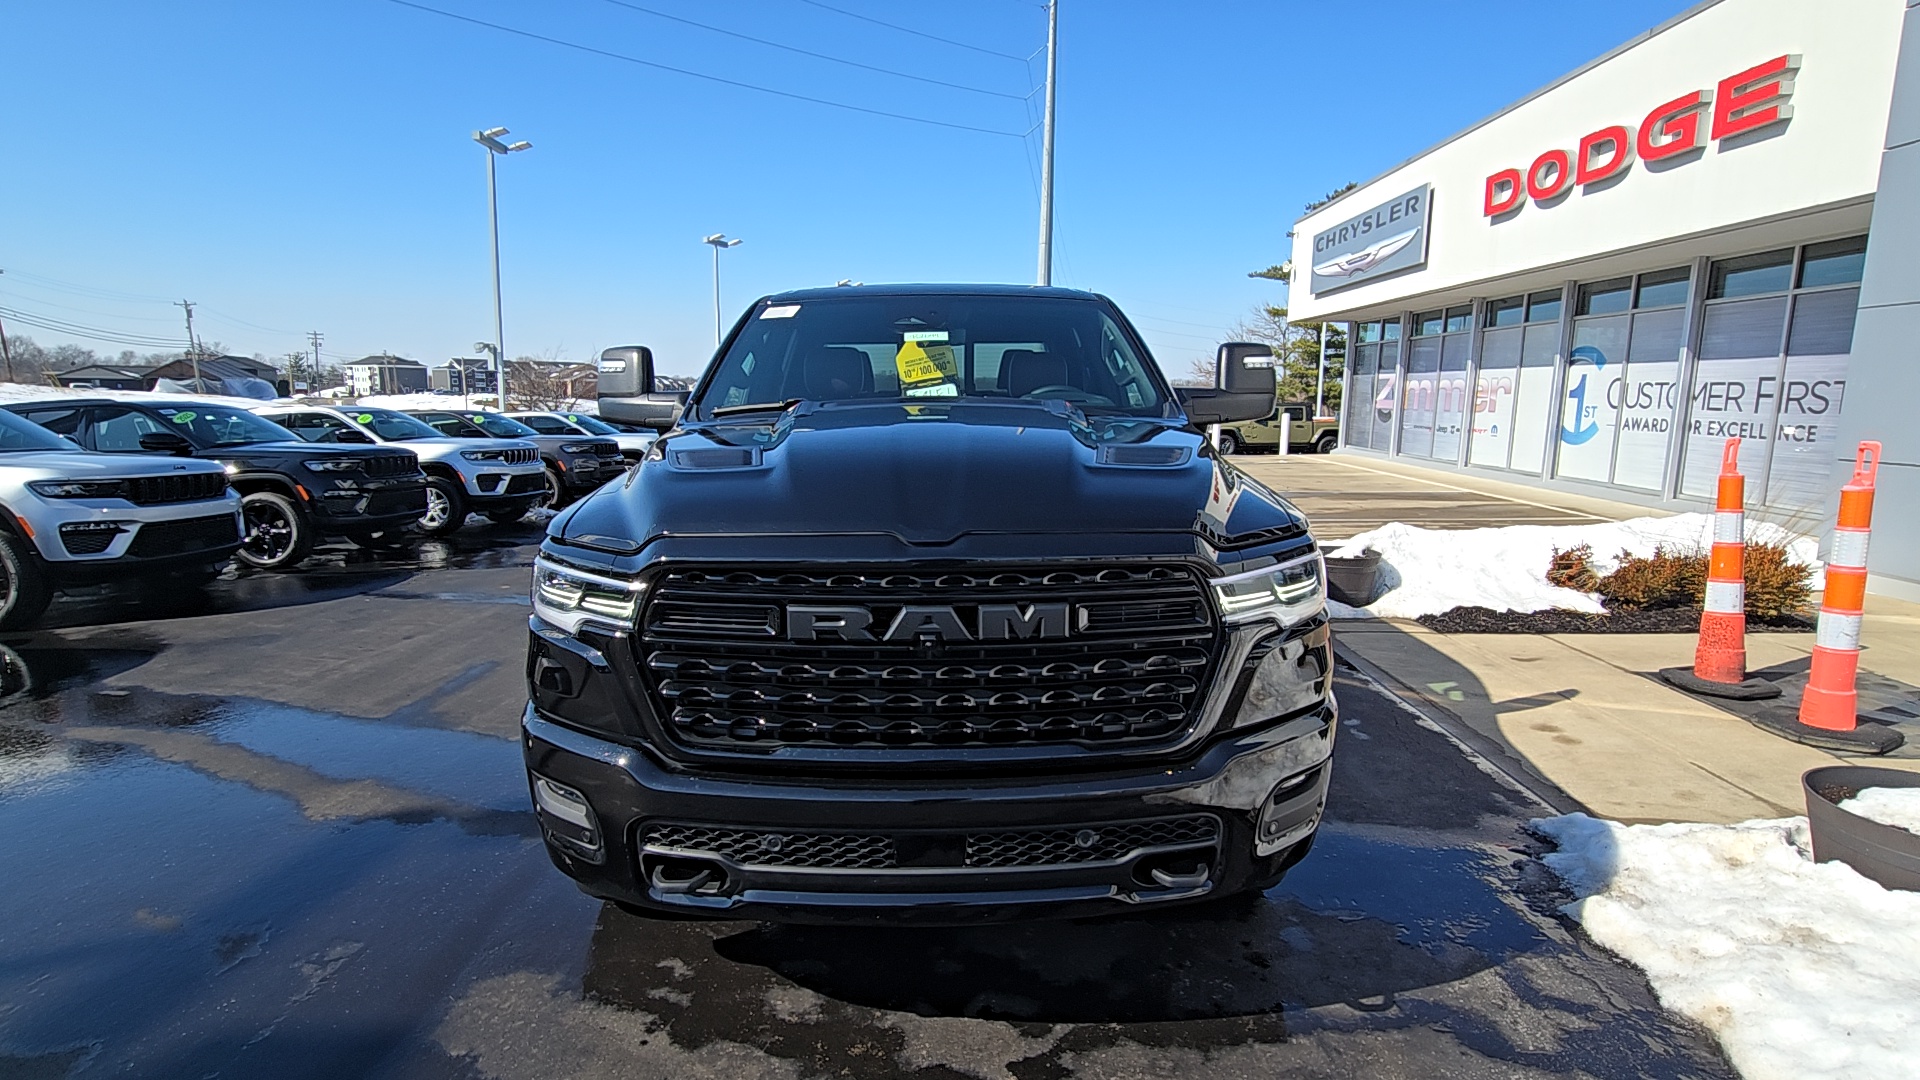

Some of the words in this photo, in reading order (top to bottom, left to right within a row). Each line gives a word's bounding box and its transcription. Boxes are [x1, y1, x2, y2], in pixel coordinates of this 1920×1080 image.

[1484, 54, 1793, 217] DODGE
[1315, 195, 1420, 252] CHRYSLER
[1376, 374, 1512, 413] Zmmer
[1753, 377, 1846, 415] FIRST
[1622, 416, 1668, 433] AWARD
[1707, 421, 1818, 443] EXCELLNCE
[786, 604, 1069, 641] RAM
